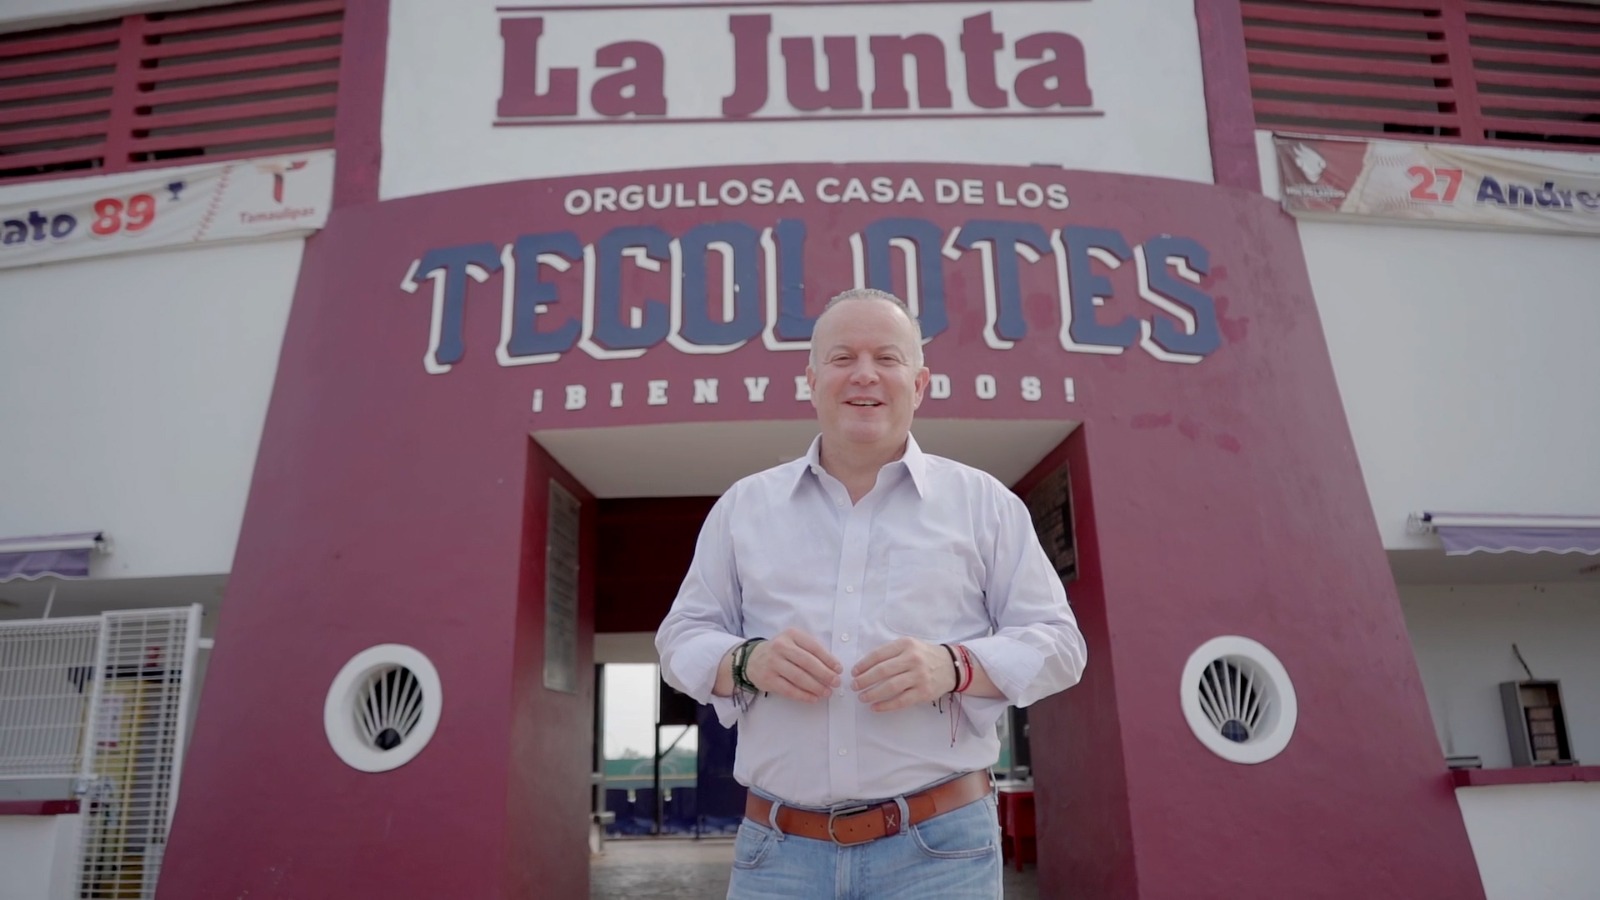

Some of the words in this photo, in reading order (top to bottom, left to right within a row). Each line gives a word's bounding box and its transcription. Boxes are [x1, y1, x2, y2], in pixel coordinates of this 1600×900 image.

[497, 16, 667, 118] La
[722, 11, 1093, 118] Junta
[564, 178, 805, 215] ORGULLOSA
[816, 176, 924, 203] CASA
[935, 178, 985, 204] DE
[996, 180, 1069, 210] LOS
[1407, 165, 1464, 203] 27
[1476, 175, 1600, 209] Andre
[0, 210, 78, 245] ato
[91, 192, 156, 236] 89
[400, 216, 1222, 374] TECOLOTES
[532, 374, 1076, 413] ¡BIENVEDOS!
